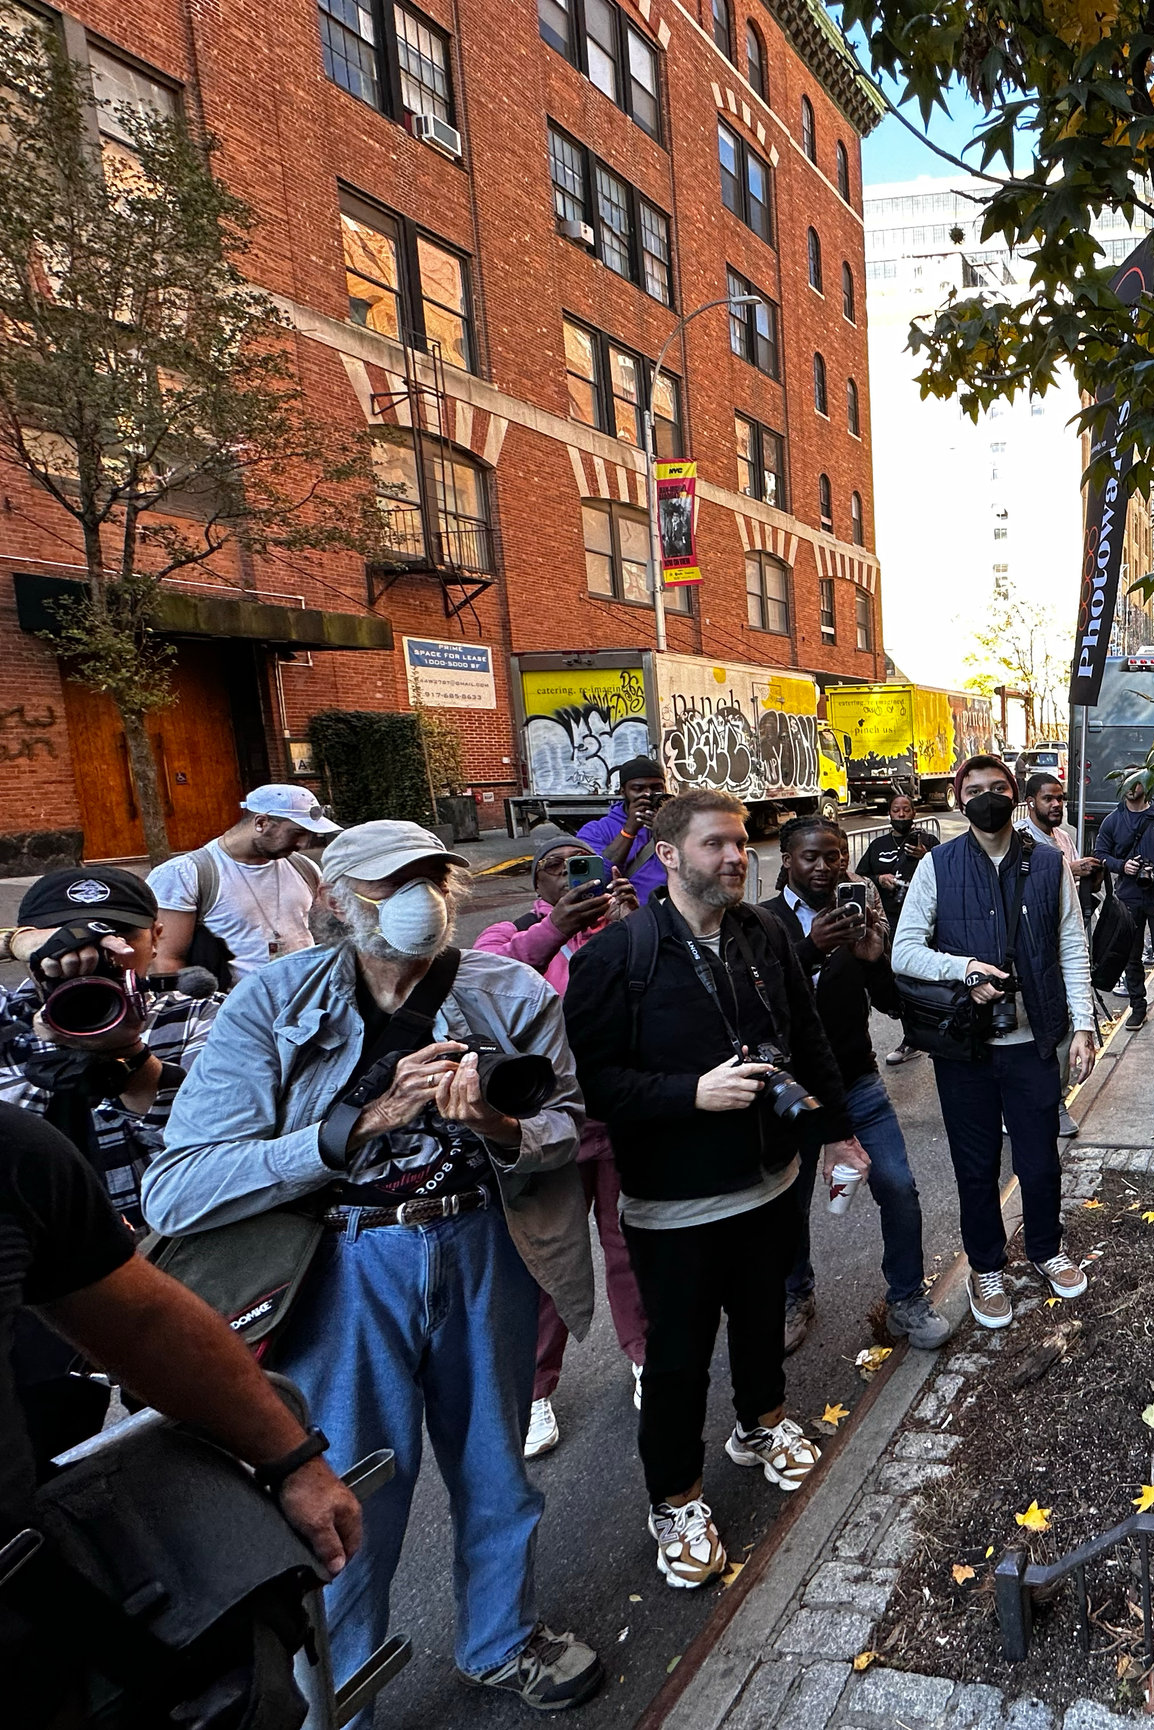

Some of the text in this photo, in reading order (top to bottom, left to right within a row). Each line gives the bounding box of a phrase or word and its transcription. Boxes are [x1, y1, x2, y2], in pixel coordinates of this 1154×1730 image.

[1078, 400, 1132, 679] Photowas
[413, 649, 488, 663] SPACE FOR LEASE
[854, 725, 880, 736] pinch
[415, 1161, 454, 1196] 2008
[229, 1298, 273, 1330] DOMKE
